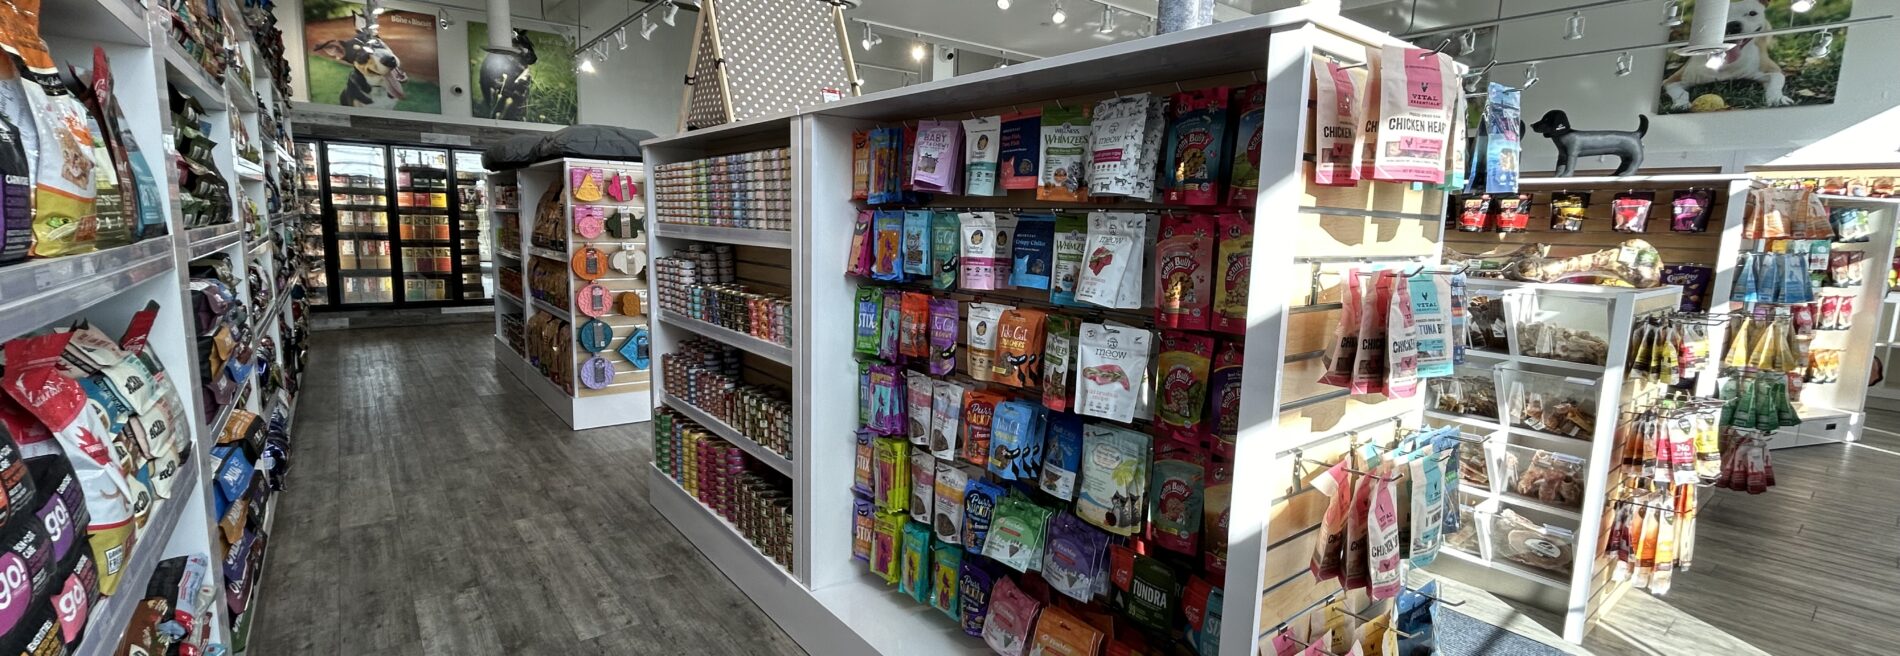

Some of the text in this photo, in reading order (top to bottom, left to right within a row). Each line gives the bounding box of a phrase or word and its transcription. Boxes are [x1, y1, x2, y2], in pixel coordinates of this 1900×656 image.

[1412, 94, 1439, 102] VITAL
[1388, 117, 1426, 133] CHICKEN
[924, 133, 948, 143] BABY
[854, 159, 869, 175] STIX
[858, 312, 875, 329] STIX
[1418, 324, 1437, 335] TUNA
[1095, 347, 1128, 360] meow
[1676, 443, 1691, 452] No
[44, 497, 69, 541] go!
[856, 525, 872, 542] STIX
[0, 557, 26, 610] go!
[59, 577, 86, 622] go!
[1132, 578, 1168, 610] TUNDRA
